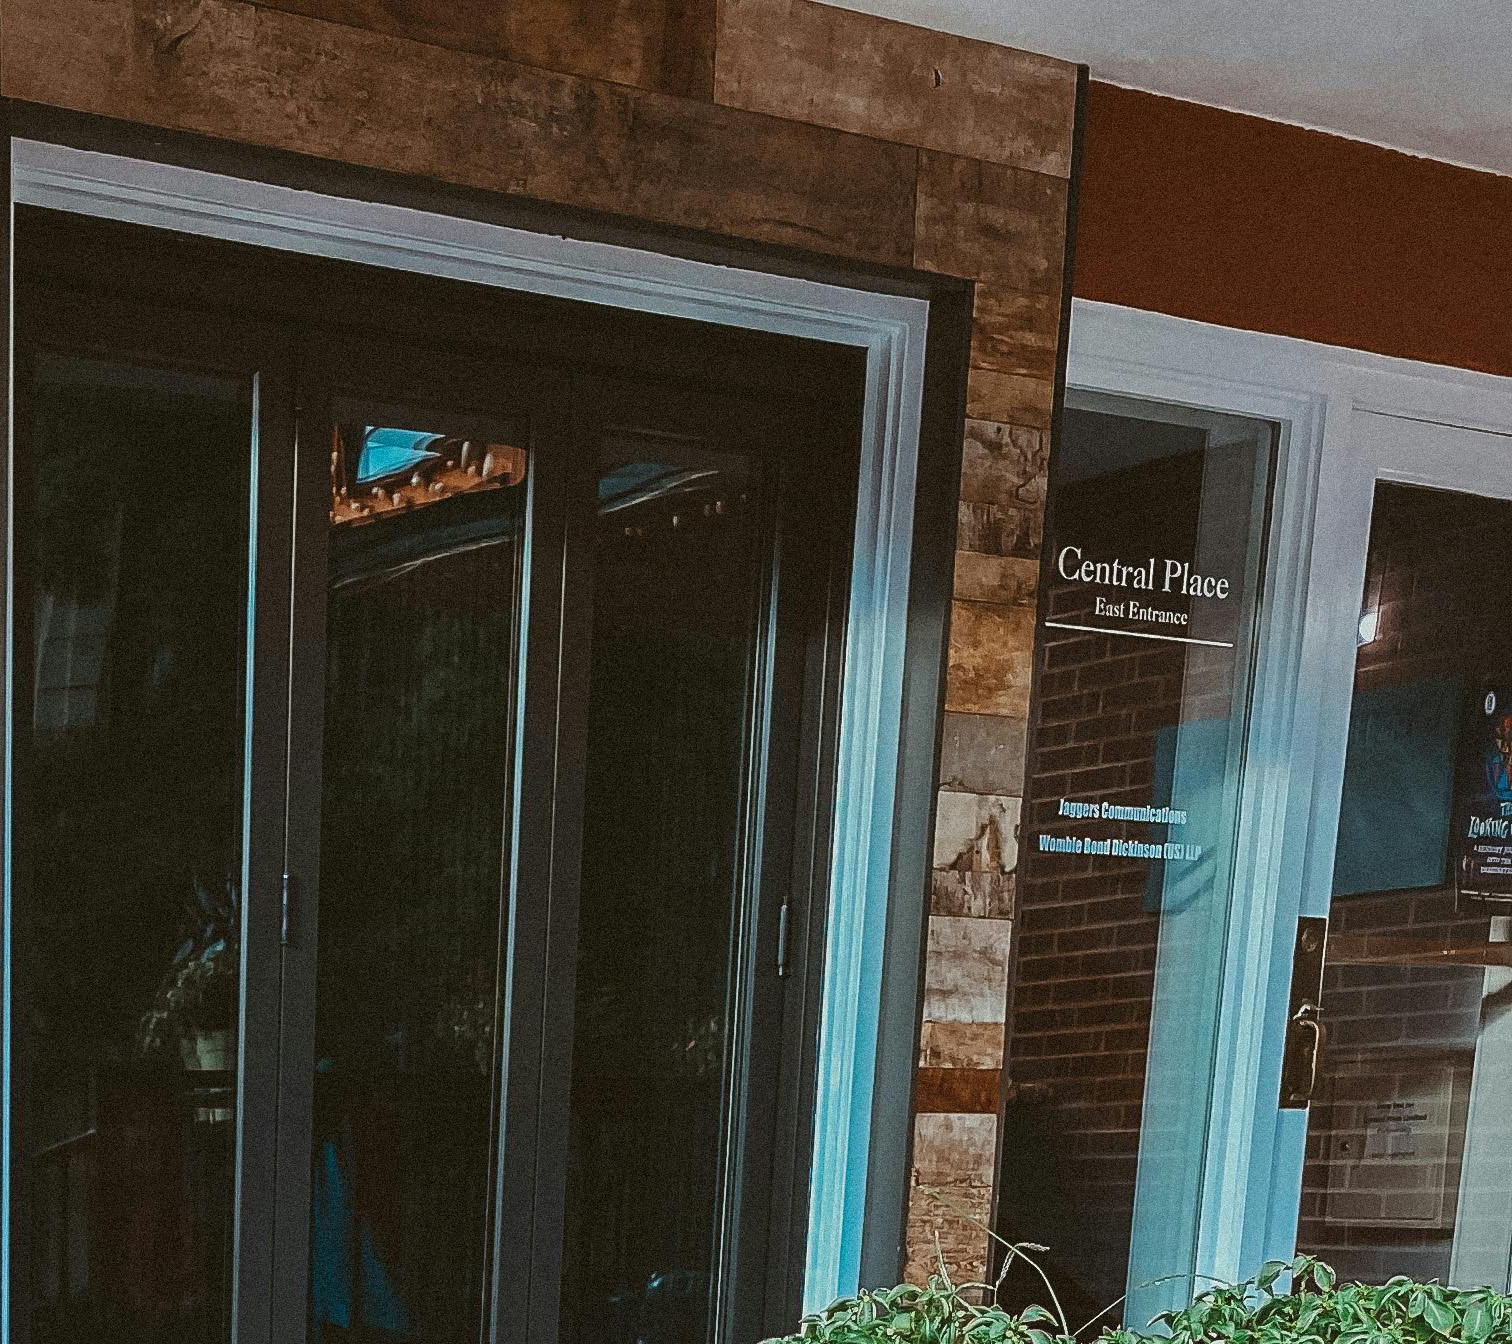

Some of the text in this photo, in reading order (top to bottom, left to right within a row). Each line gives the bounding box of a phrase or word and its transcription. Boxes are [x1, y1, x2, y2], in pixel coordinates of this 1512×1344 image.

[1058, 546, 1230, 600] Central Place
[1094, 596, 1189, 626] East Entrance
[1058, 798, 1188, 825] Jaggers Communications
[1039, 834, 1083, 854] Womble
[1084, 837, 1111, 856] Bond
[1112, 839, 1163, 860] Dickinson
[1164, 842, 1185, 861] (US)
